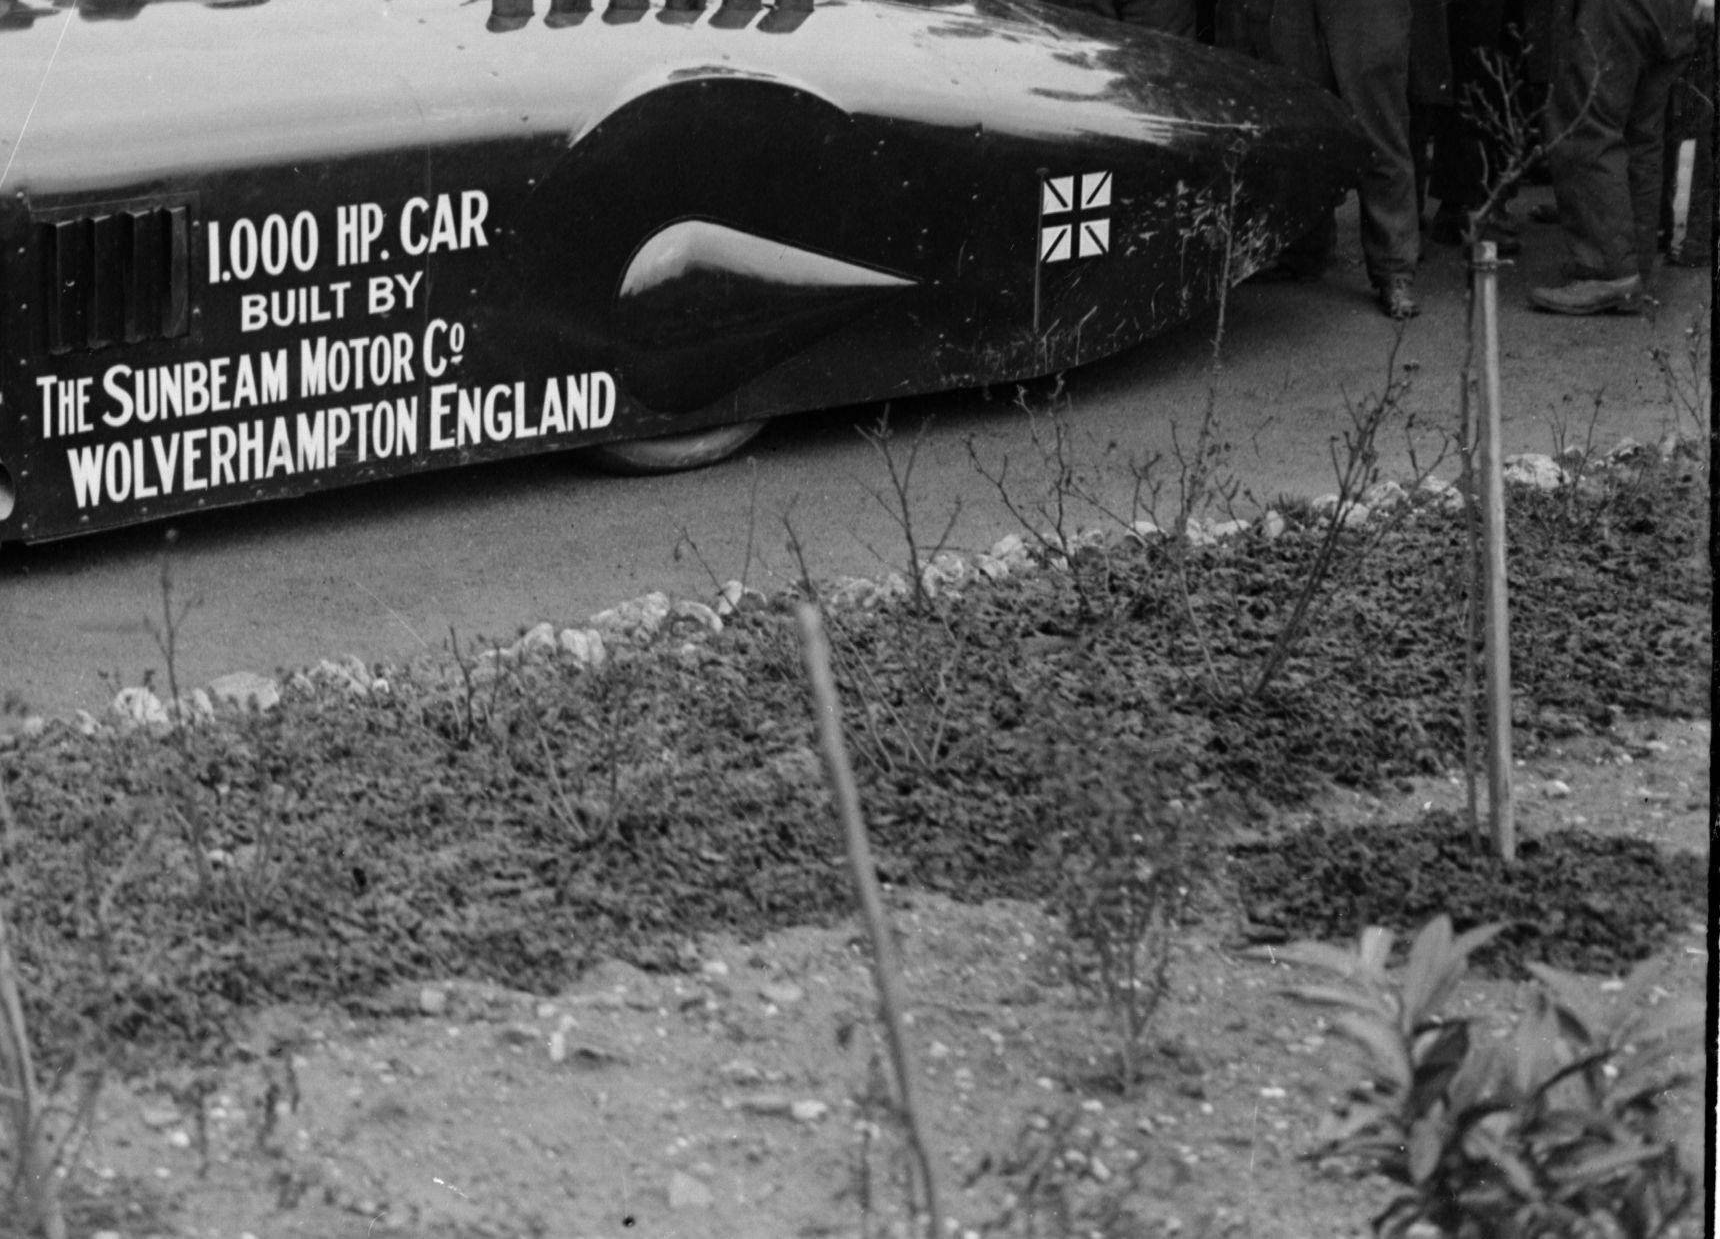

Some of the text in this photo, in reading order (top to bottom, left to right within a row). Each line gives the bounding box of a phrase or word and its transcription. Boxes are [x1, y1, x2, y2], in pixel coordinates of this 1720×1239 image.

[400, 189, 490, 257] CAR
[241, 270, 424, 333] BUILT BY
[36, 374, 94, 439] THE
[102, 347, 288, 428] SUNBEAM
[300, 332, 415, 398] MOTOR
[67, 370, 616, 508] WOLVERHAMPTON ENGLAND
